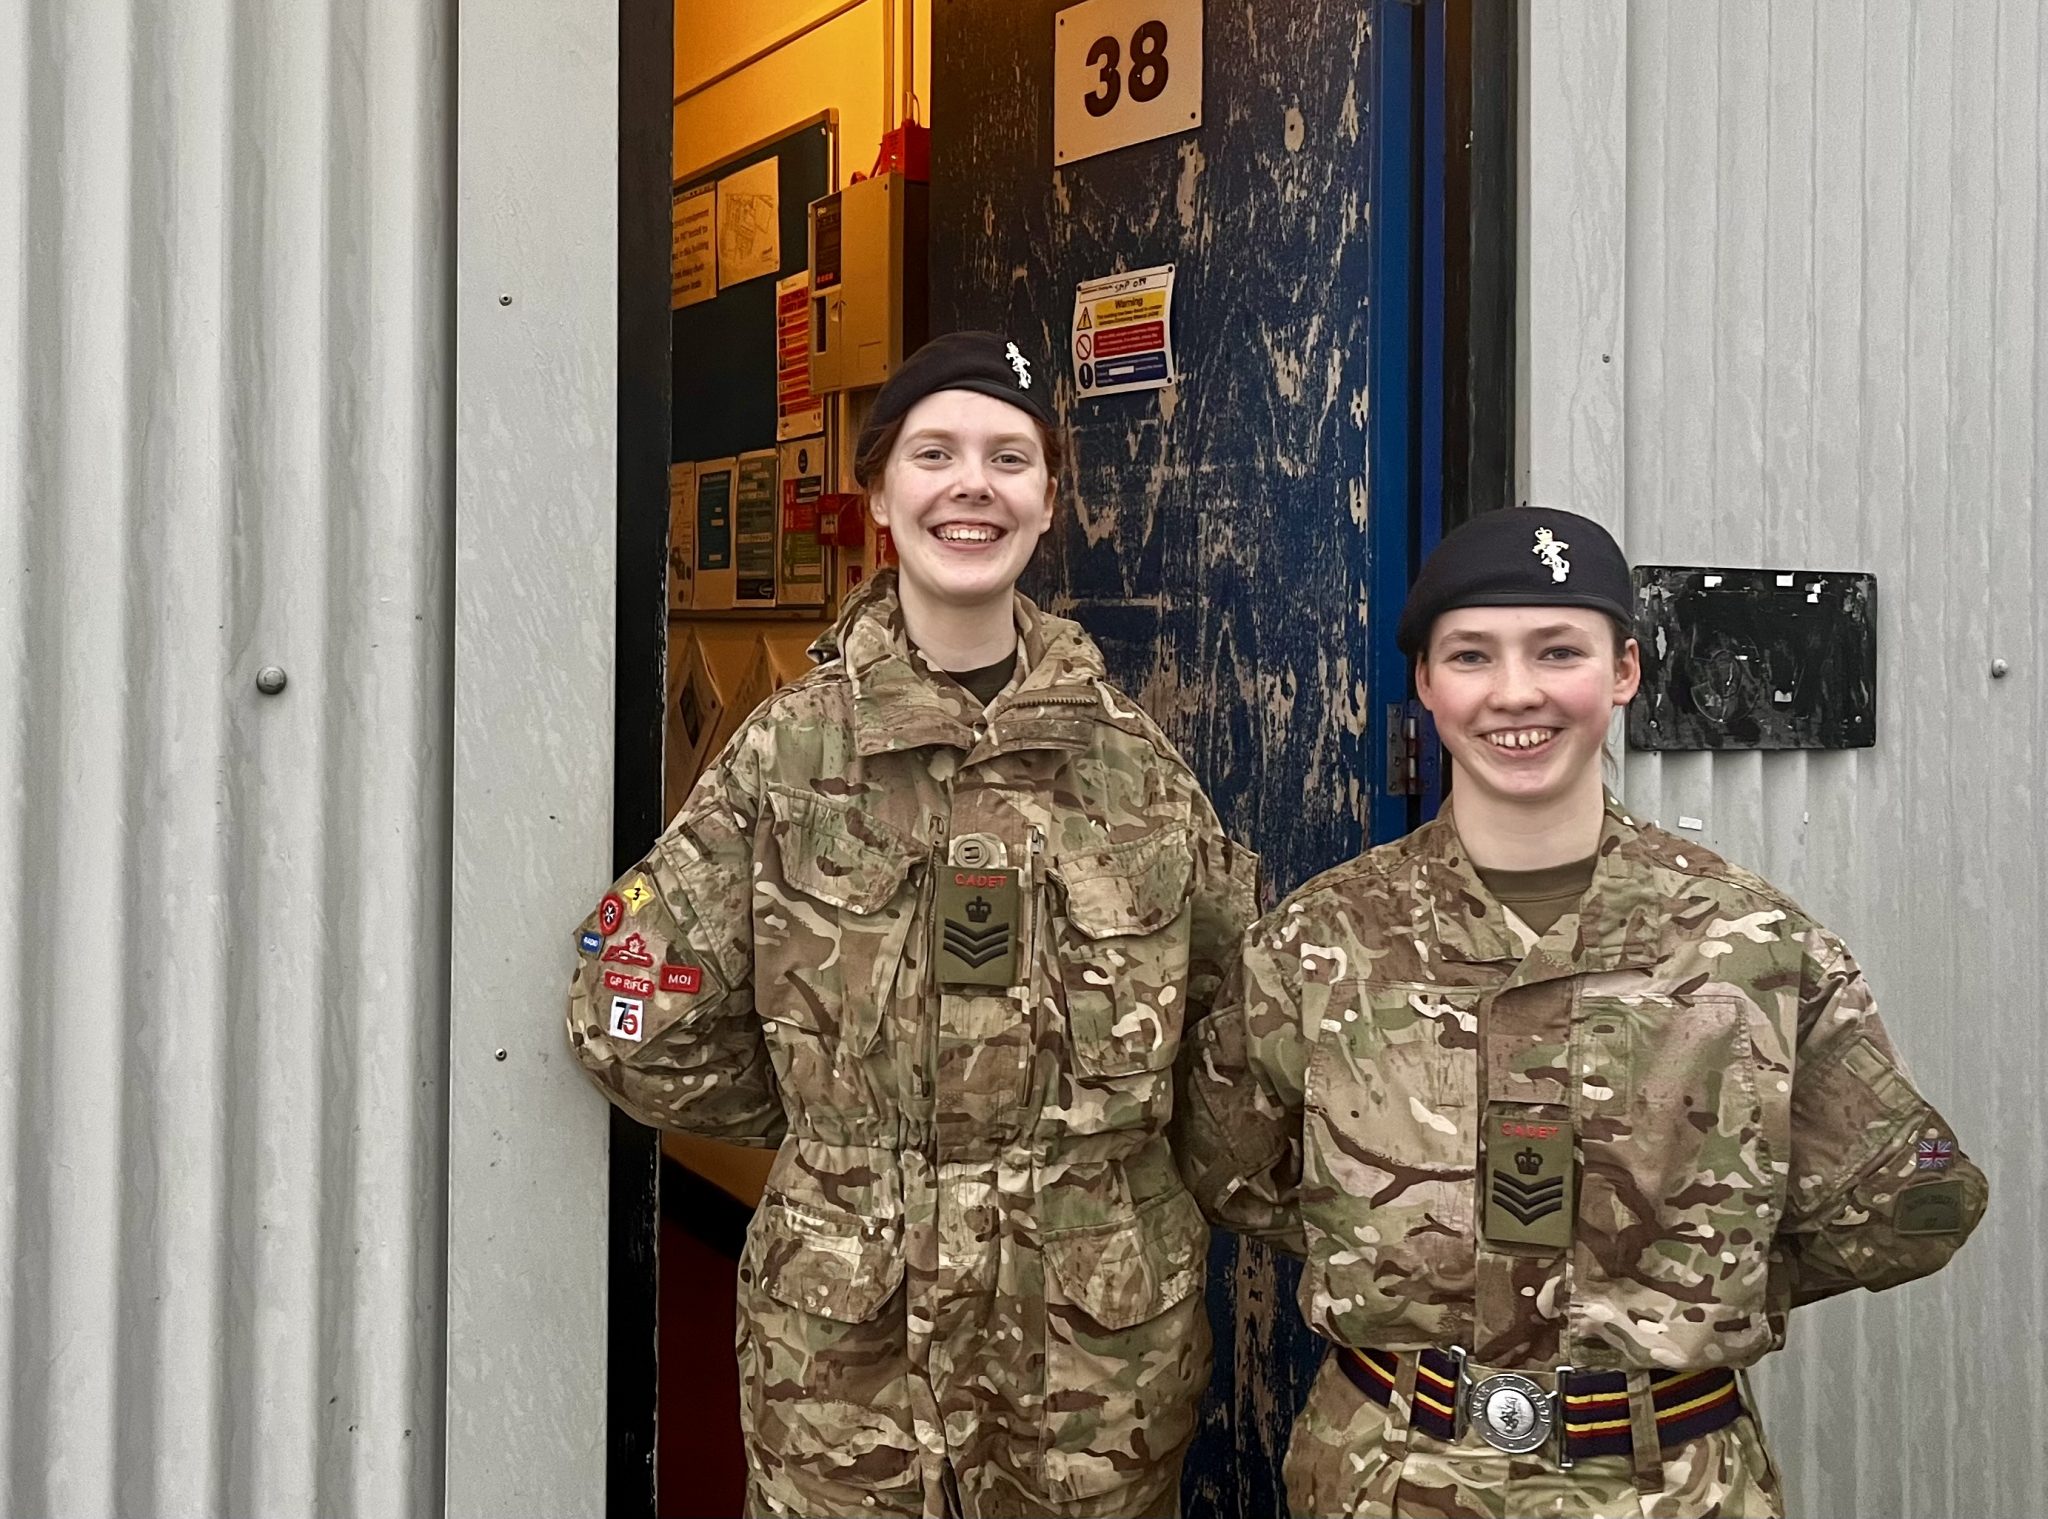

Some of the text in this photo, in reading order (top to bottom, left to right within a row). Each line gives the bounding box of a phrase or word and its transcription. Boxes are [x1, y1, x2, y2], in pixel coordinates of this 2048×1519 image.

[1084, 20, 1169, 117] 38
[1115, 298, 1143, 309] Warning
[955, 873, 1007, 888] CADET
[632, 887, 641, 901] 3
[609, 975, 650, 993] GP RIFLE
[667, 973, 692, 986] MOI
[615, 1001, 639, 1035] 75
[1501, 1122, 1561, 1140] CADET
